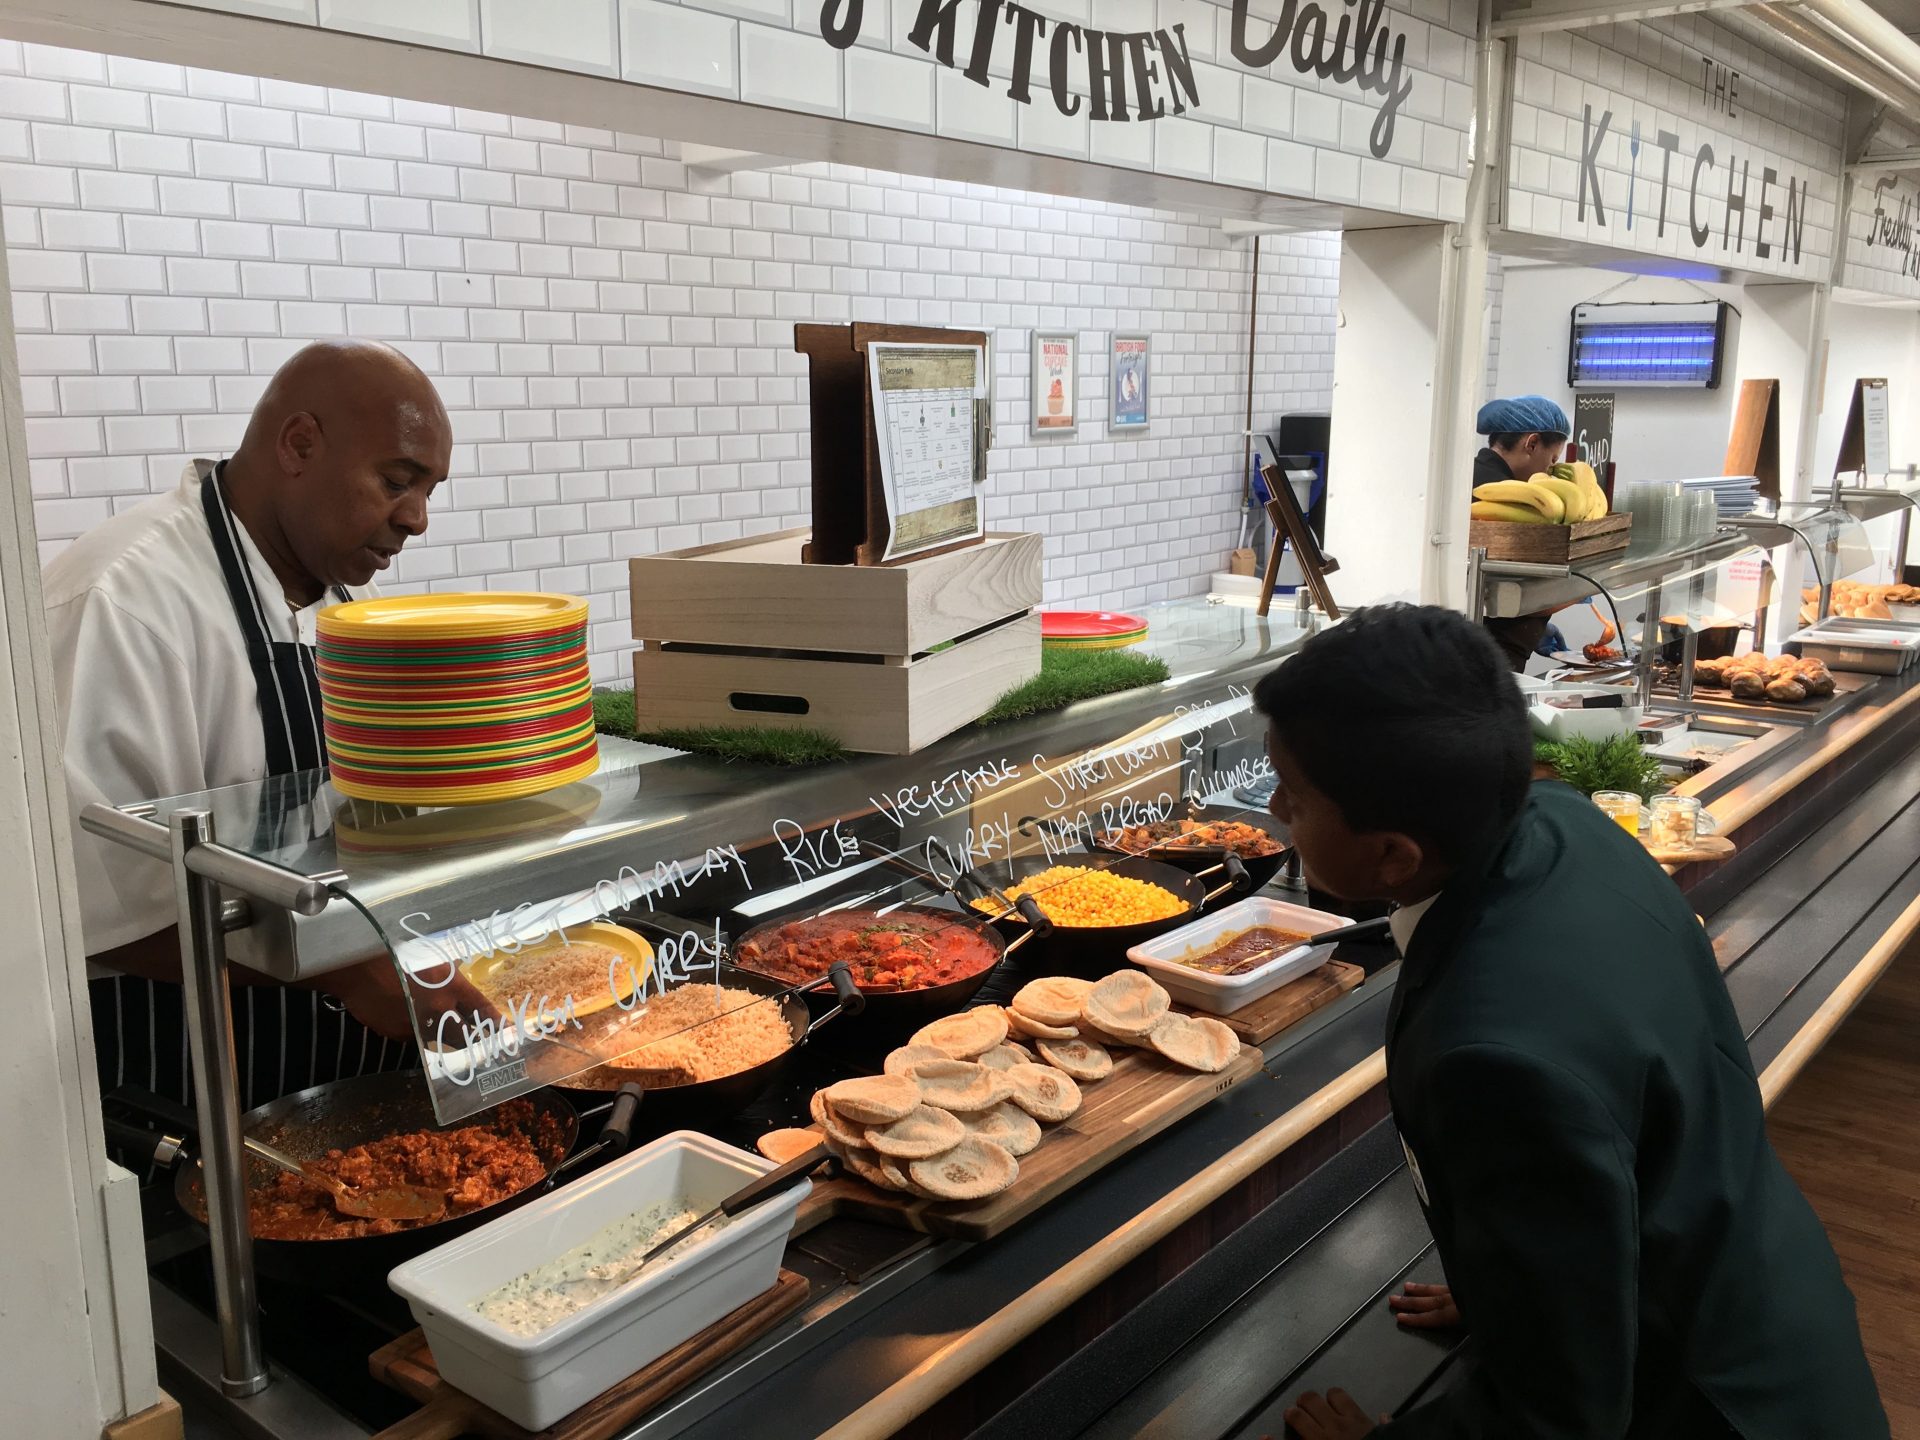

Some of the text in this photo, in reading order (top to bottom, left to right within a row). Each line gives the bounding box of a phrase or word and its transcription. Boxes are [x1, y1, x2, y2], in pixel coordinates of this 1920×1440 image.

[908, 0, 1201, 122] KITCHEN
[1701, 57, 1740, 119] THE
[1043, 343, 1069, 356] NATIONAL
[772, 818, 861, 889] RICE
[926, 811, 1014, 889] CURRY
[608, 916, 727, 1009] CURRY
